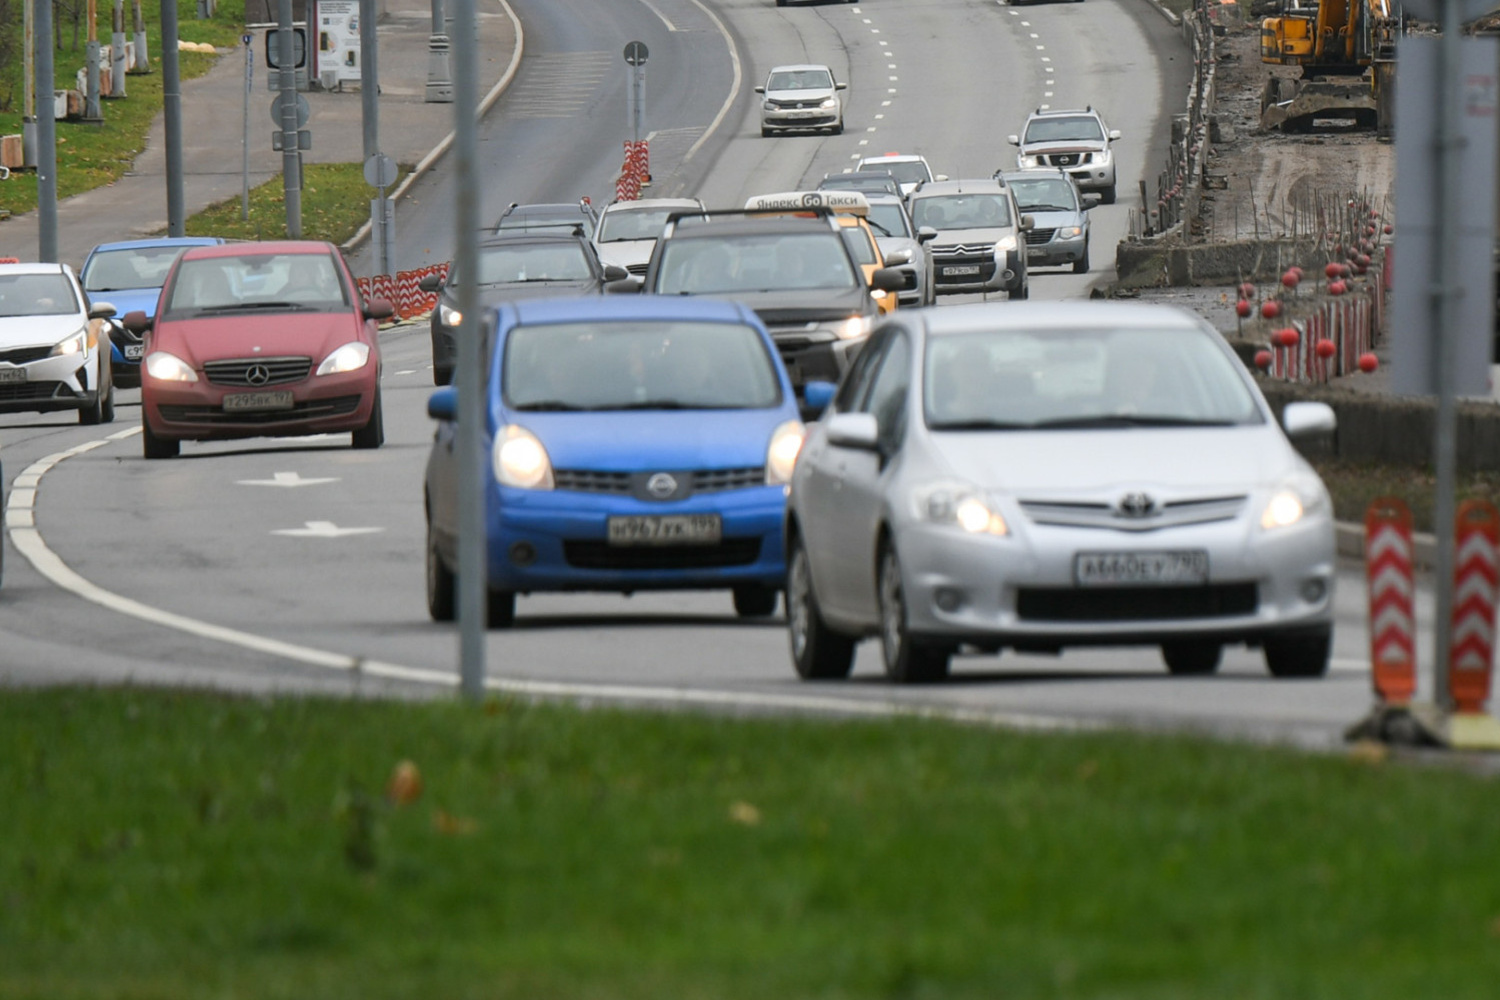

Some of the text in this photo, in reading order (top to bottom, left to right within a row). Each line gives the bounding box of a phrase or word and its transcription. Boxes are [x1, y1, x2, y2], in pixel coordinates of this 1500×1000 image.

[757, 195, 858, 209] Яндекс Go Такси
